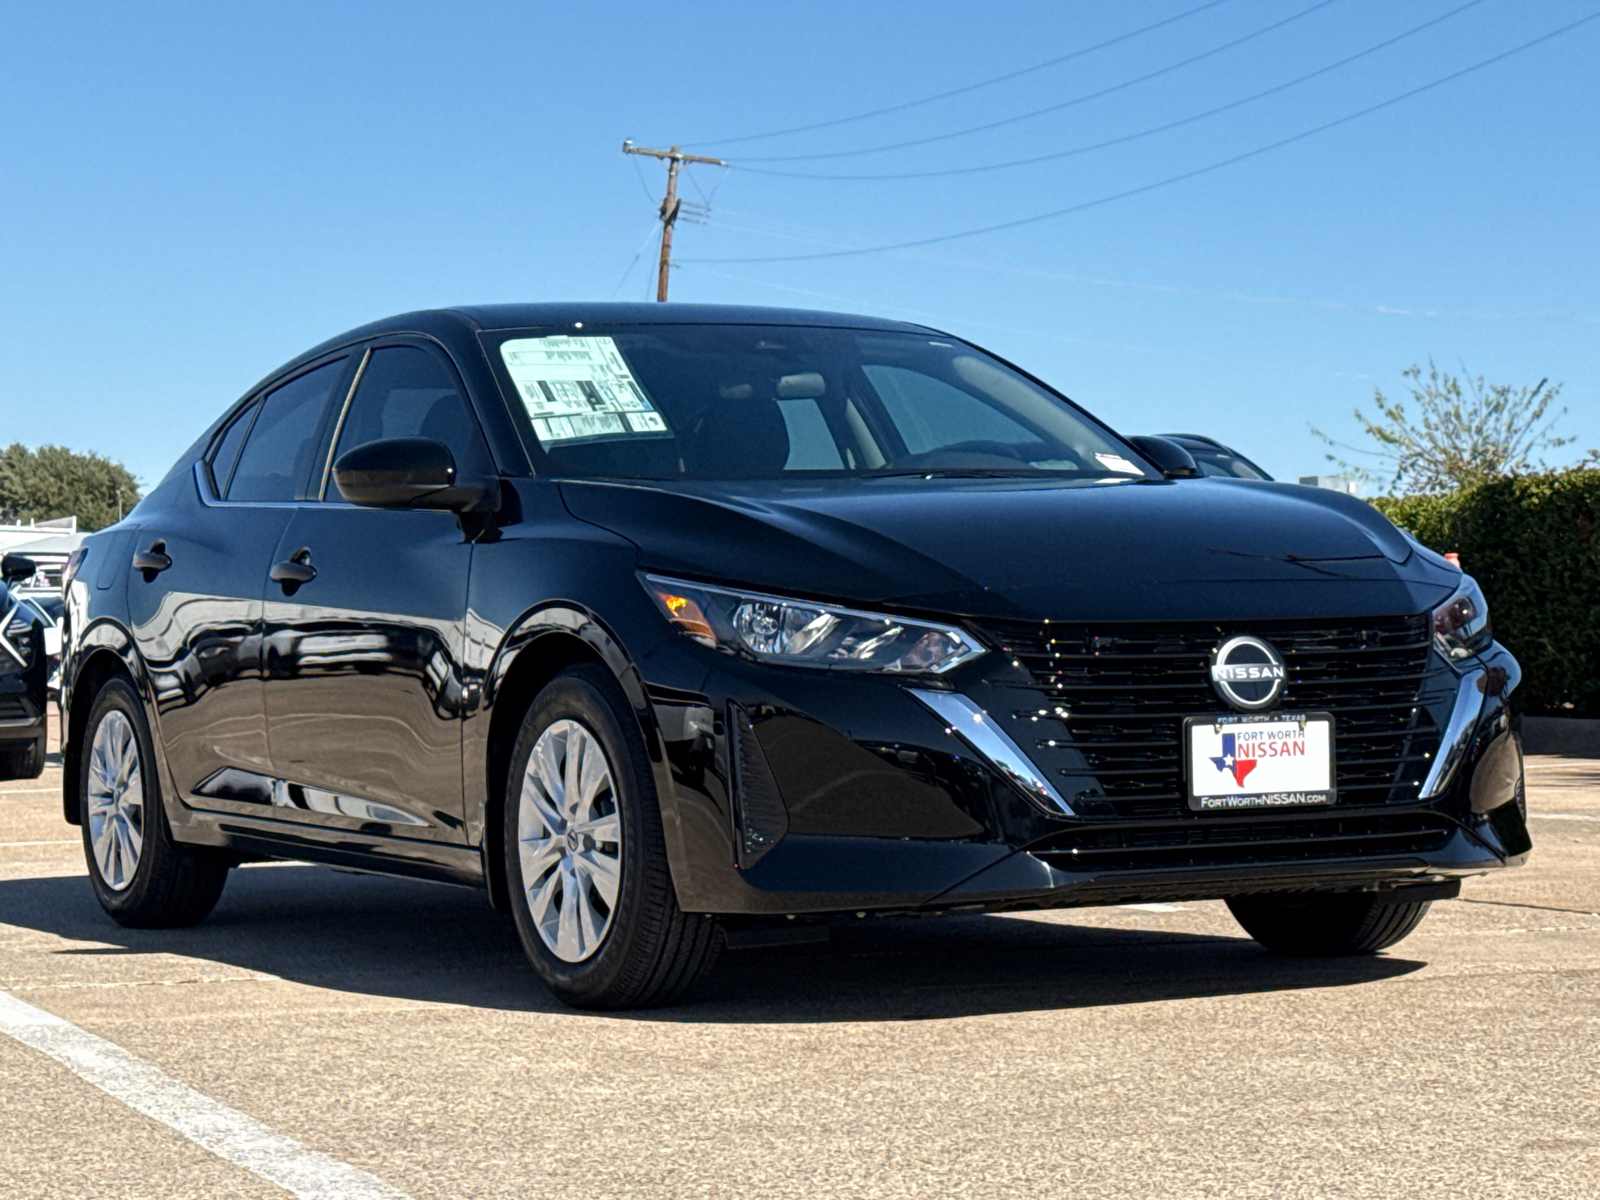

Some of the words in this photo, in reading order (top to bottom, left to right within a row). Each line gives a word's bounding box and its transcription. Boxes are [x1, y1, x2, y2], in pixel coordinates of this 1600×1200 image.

[1214, 666, 1285, 680] NISSAN
[1217, 716, 1238, 724] FORT
[1241, 715, 1270, 723] WORTH
[1281, 714, 1306, 722] TEXAS
[1237, 731, 1264, 741] FORT
[1267, 730, 1305, 740] WORTH
[1238, 741, 1305, 758] NISSAN
